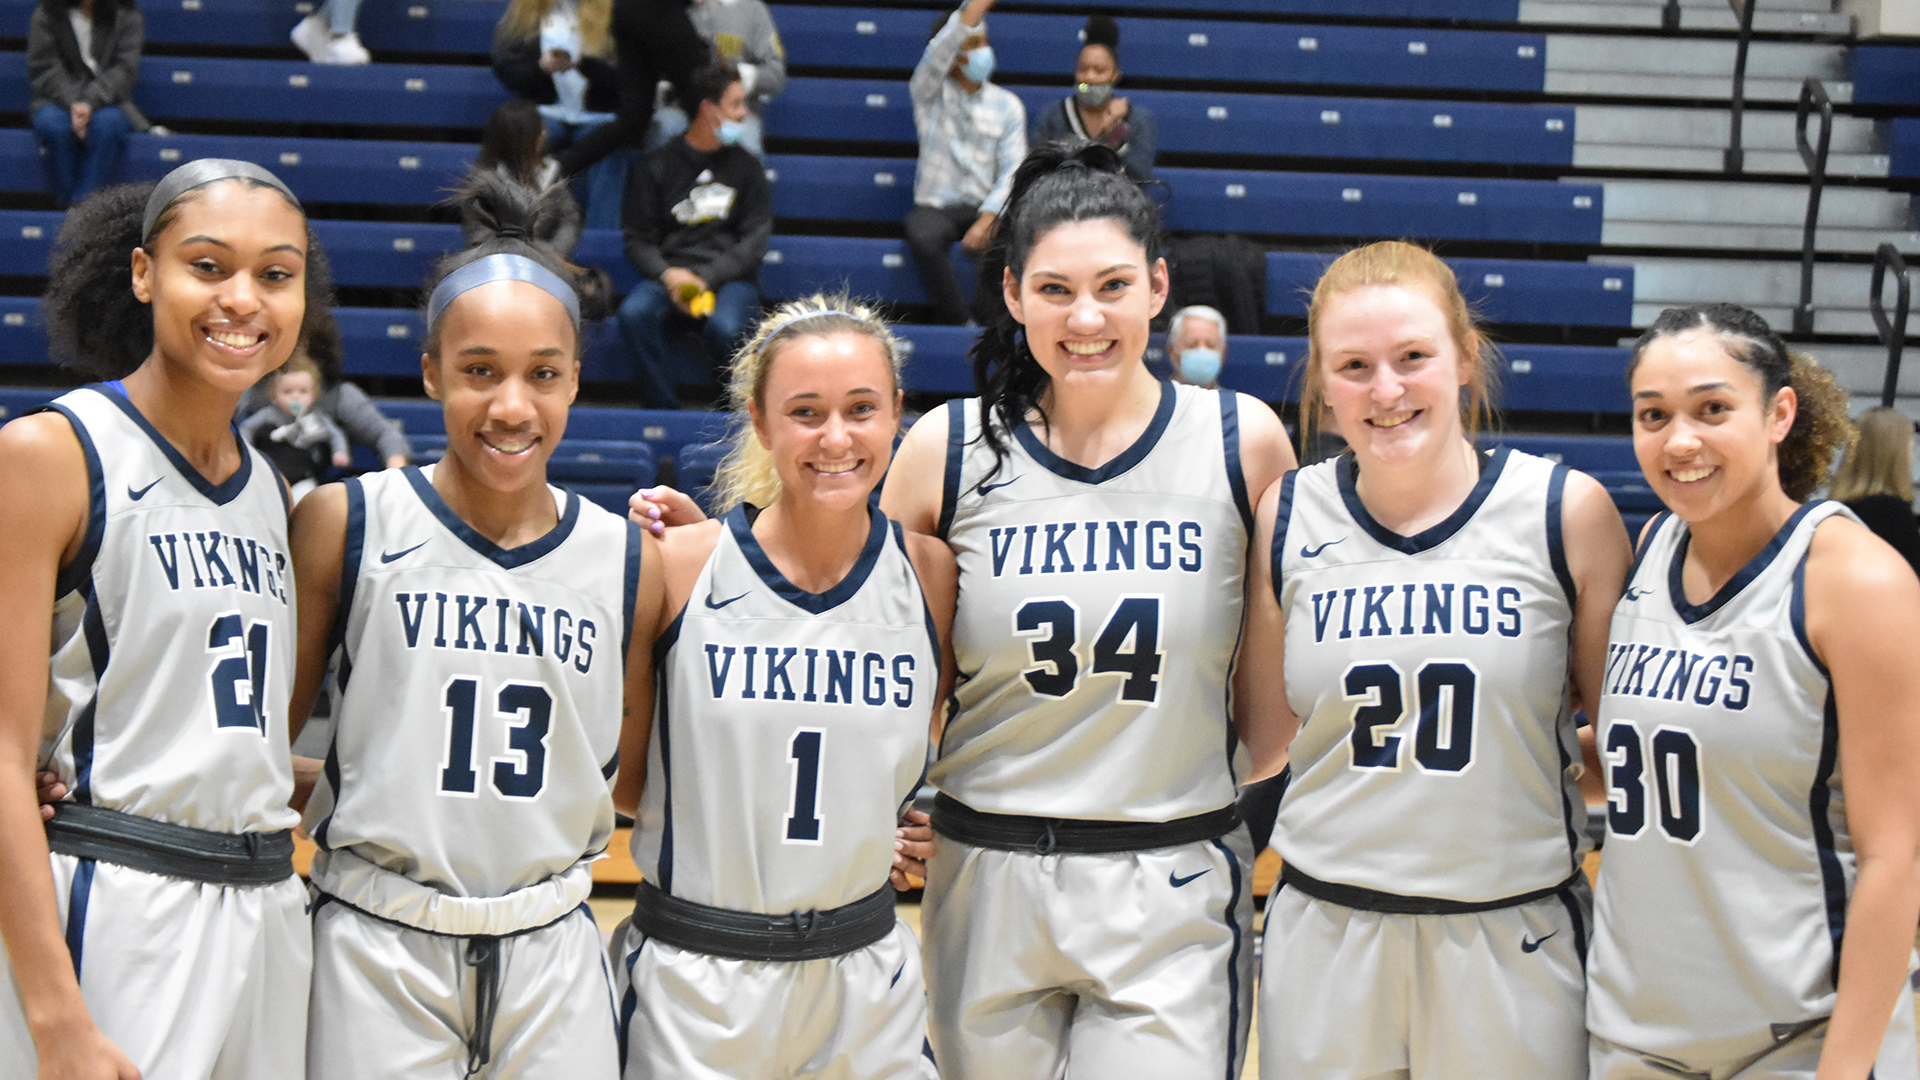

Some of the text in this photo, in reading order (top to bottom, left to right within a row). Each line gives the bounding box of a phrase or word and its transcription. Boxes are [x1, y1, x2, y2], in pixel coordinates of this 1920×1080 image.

[149, 531, 287, 605] VIKNGS
[989, 520, 1202, 577] VIKINGS
[395, 591, 596, 674] VIKINGS
[1016, 597, 1162, 703] 34
[1311, 583, 1522, 643] VIKINGS
[208, 614, 267, 737] 21
[704, 643, 916, 708] VIKINGS
[1344, 663, 1476, 772] 20
[440, 678, 553, 798] 13
[786, 731, 822, 841] 1
[1606, 723, 1701, 842] 30
